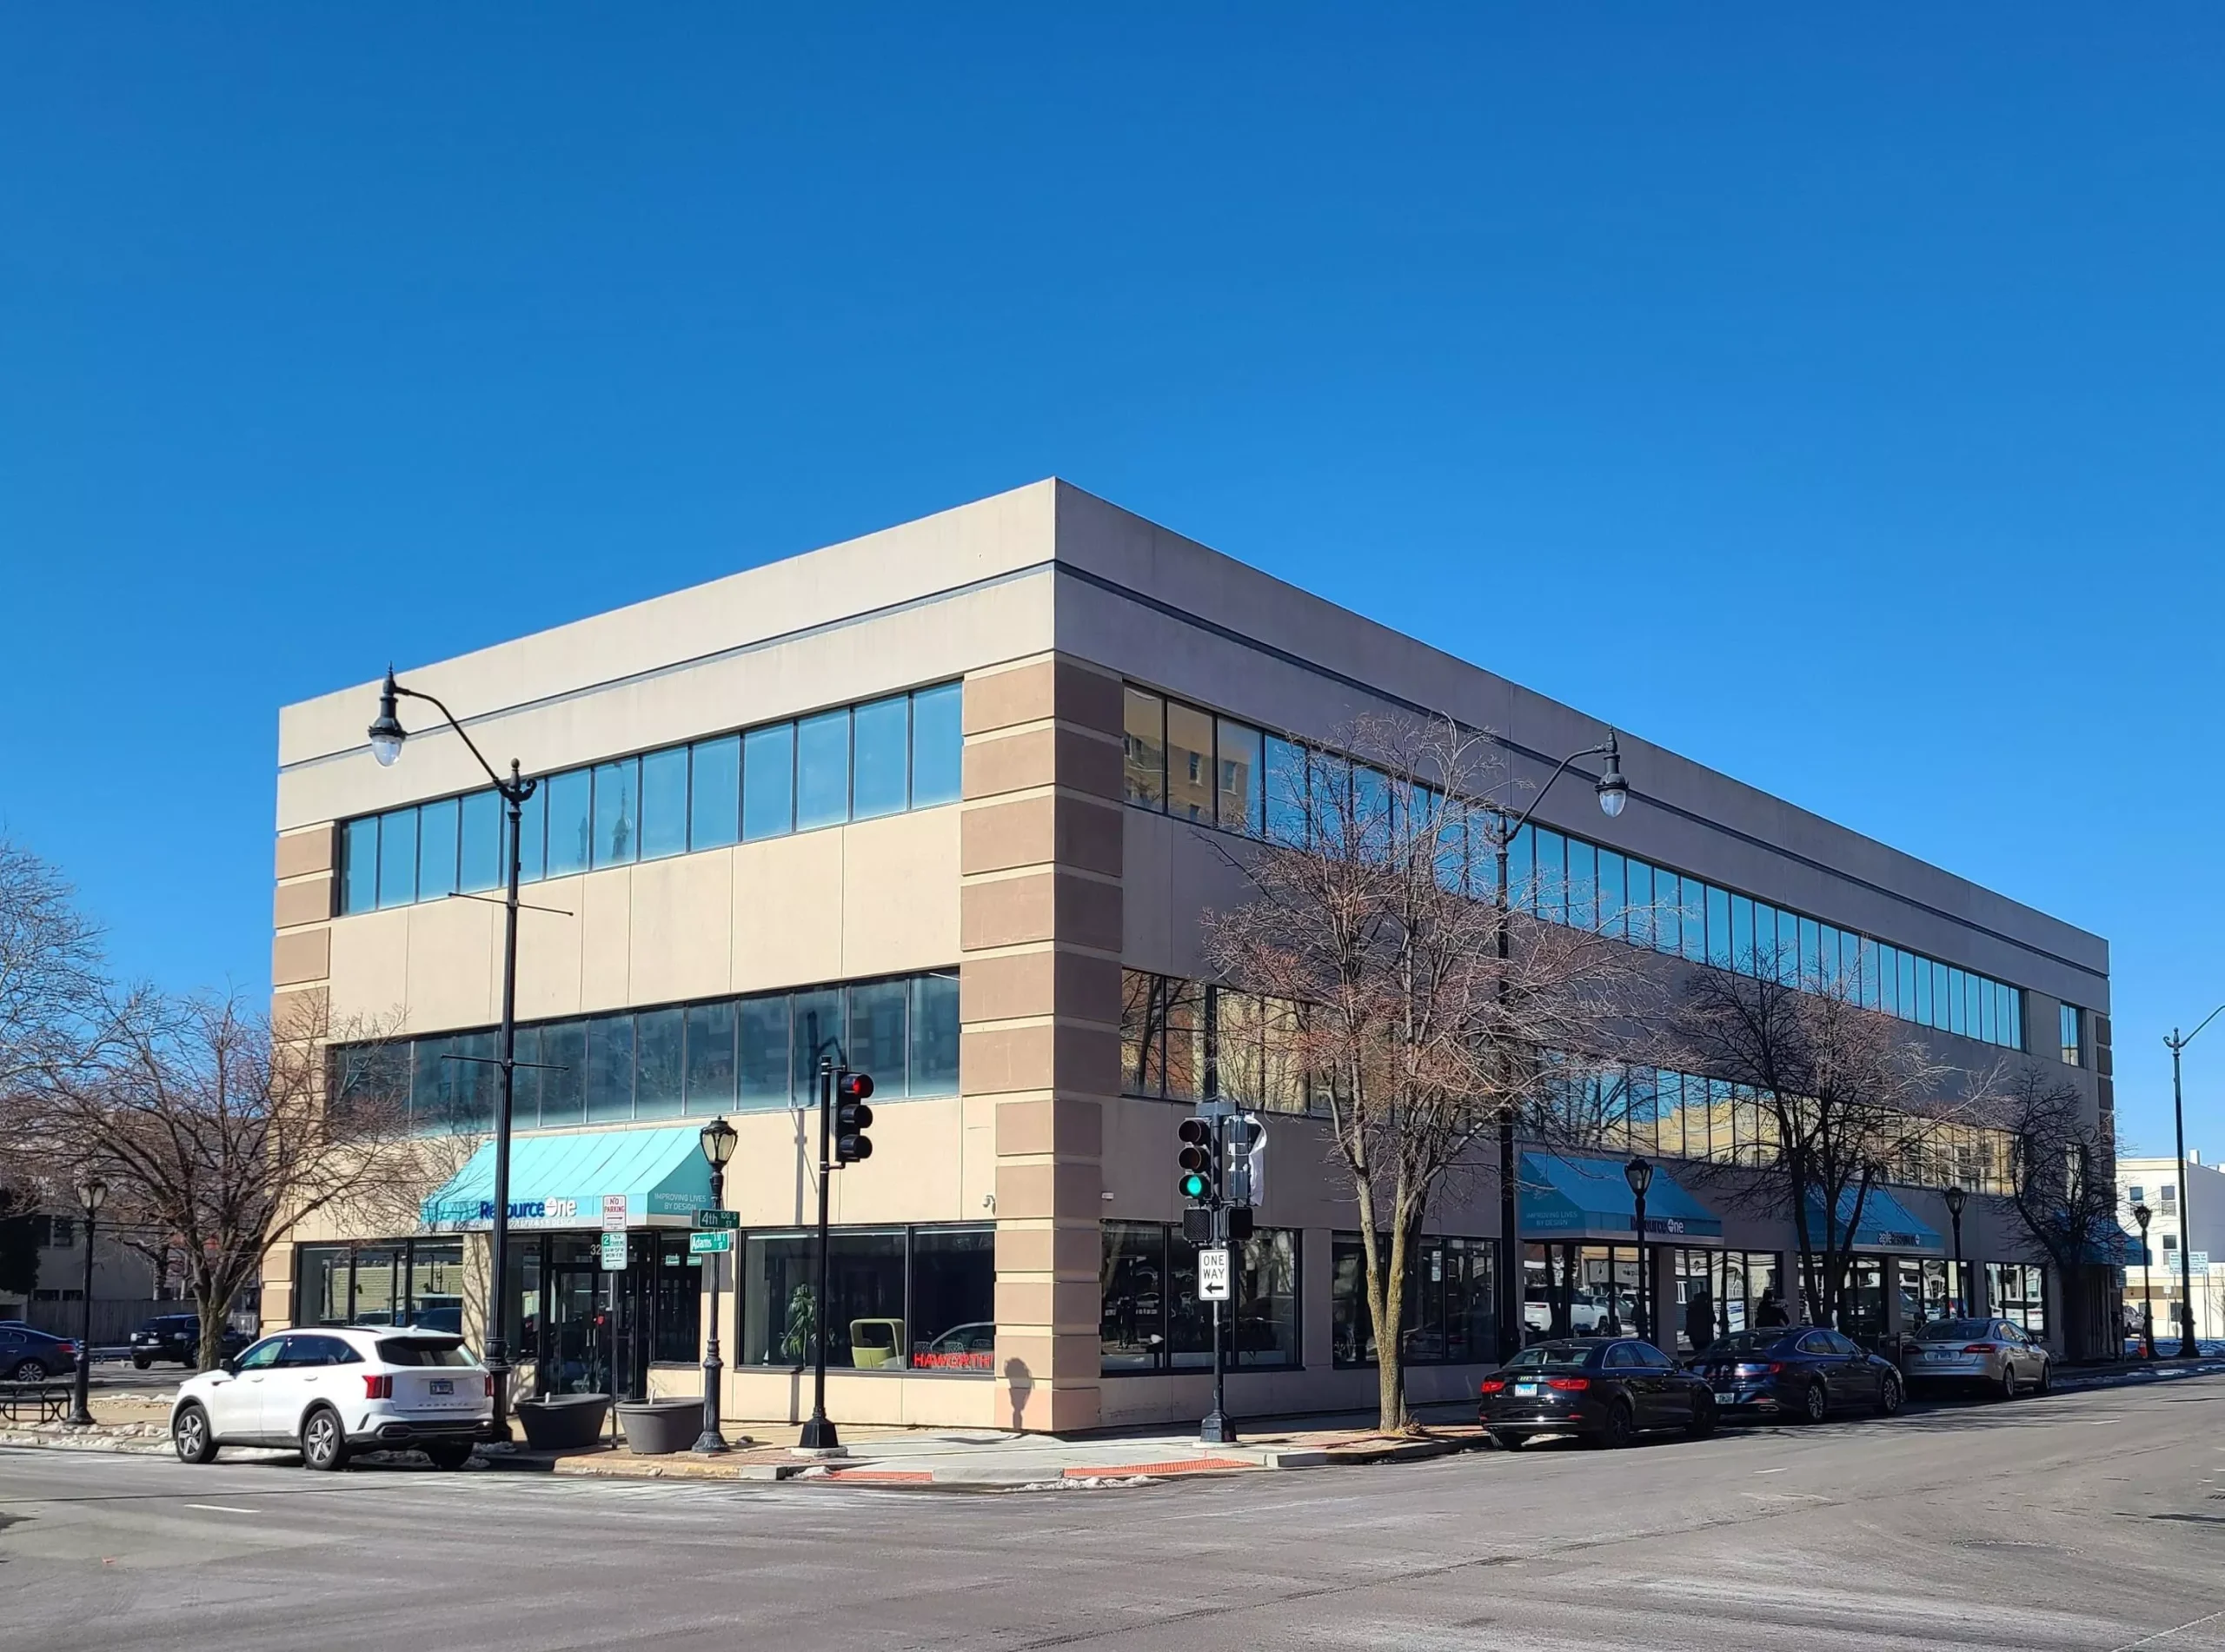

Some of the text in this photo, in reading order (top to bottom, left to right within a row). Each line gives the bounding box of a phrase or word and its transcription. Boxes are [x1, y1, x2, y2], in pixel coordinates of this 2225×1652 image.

[654, 1193, 707, 1203] IMPROVING LIVES
[480, 1197, 577, 1220] ReourceOne
[701, 1211, 718, 1226] 4th
[603, 1235, 609, 1245] 2
[692, 1236, 713, 1250] Adams
[1203, 1255, 1225, 1266] ONE
[1203, 1268, 1225, 1279] WAY
[914, 1353, 991, 1368] HAWORTH
